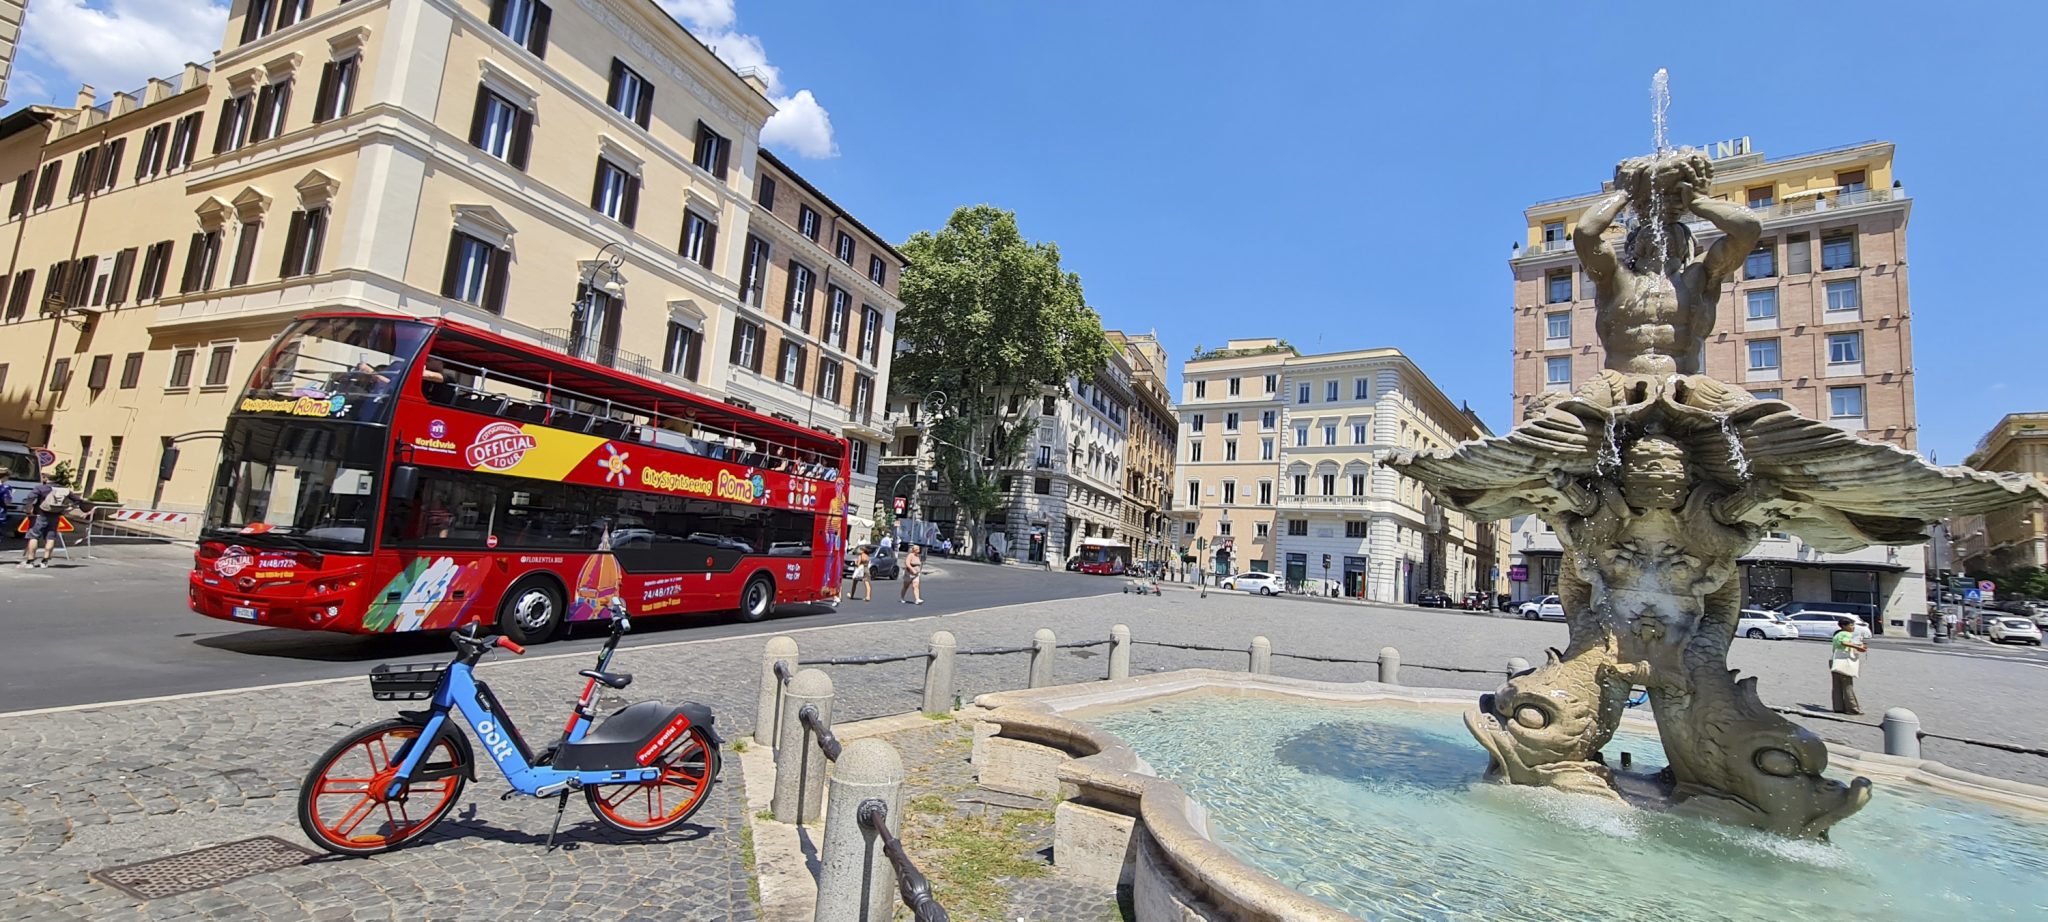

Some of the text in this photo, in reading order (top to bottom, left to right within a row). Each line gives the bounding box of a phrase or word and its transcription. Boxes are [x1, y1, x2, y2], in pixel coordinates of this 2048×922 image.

[293, 396, 332, 417] Roma
[474, 436, 534, 461] OFFICIAL
[494, 453, 520, 467] TOUR
[642, 466, 754, 503] CitySightseeing Roma
[477, 720, 513, 762] dott
[639, 743, 659, 761] Prova
